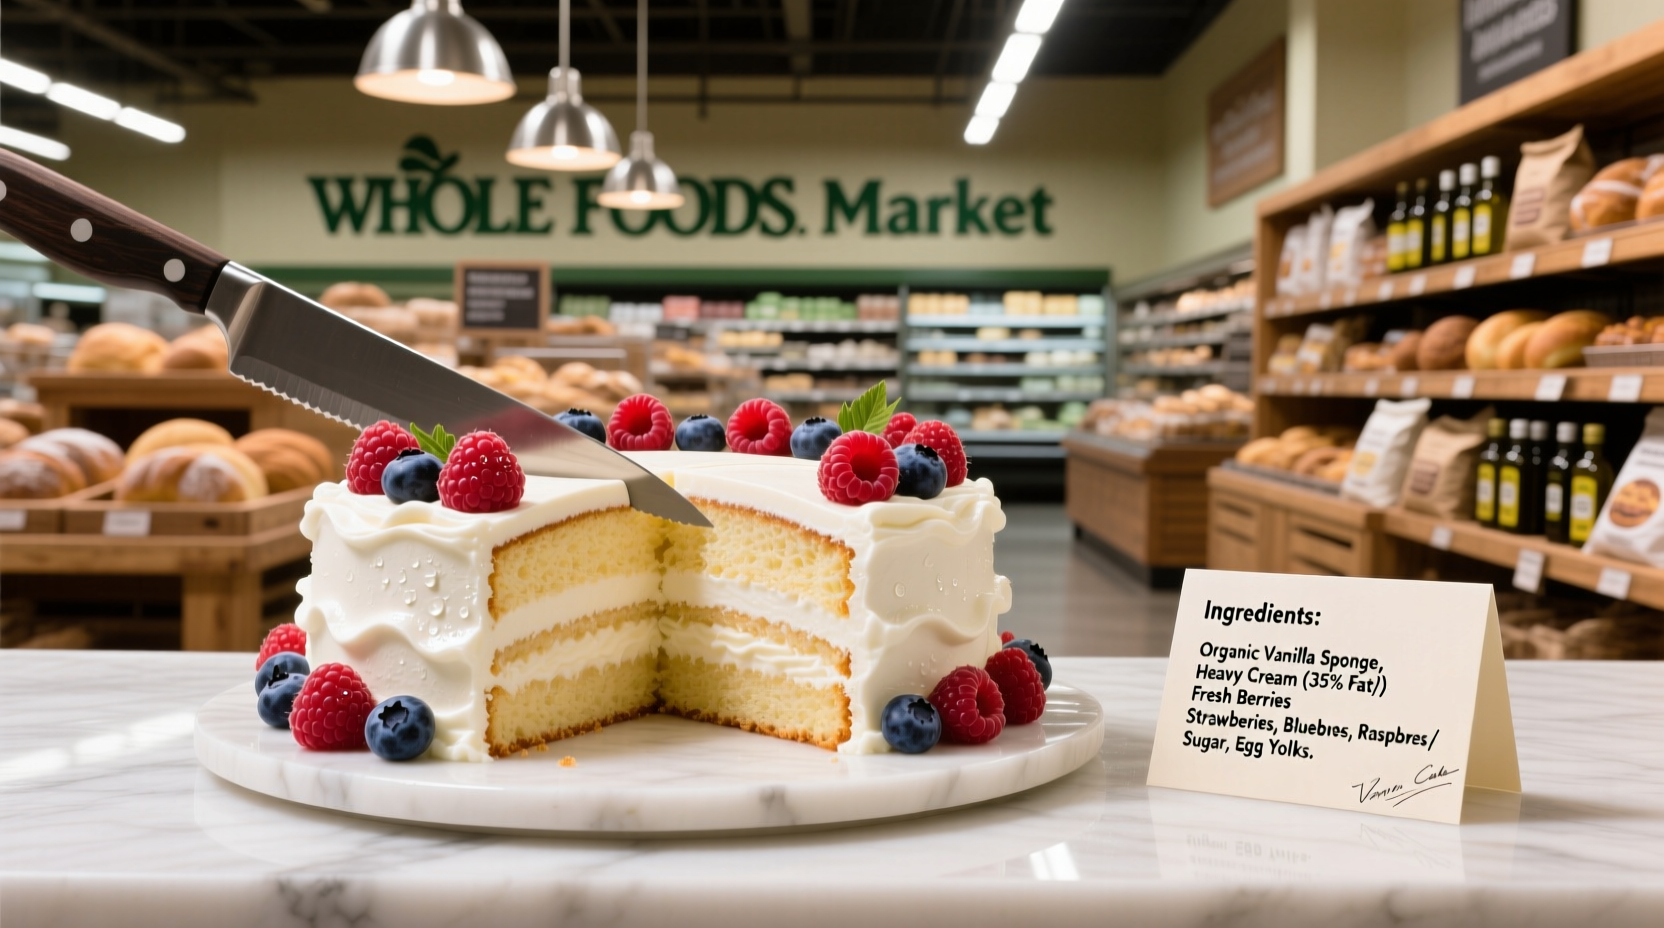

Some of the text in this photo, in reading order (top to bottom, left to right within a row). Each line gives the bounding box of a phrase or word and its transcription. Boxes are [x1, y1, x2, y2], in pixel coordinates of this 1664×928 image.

[308, 175, 554, 237] WHOLE
[822, 175, 1056, 238] Market
[1204, 599, 1321, 626] Ingredients:
[1199, 641, 1384, 674] Organic Vanilla Sponge,
[1195, 663, 1243, 686] Heavy
[1247, 666, 1298, 687] Cream
[1302, 669, 1344, 692] (35%
[1191, 685, 1292, 709] Fresh Berries
[1185, 707, 1278, 736] Strawberies,
[1182, 730, 1314, 760] Sugar, Egg Yolks.
